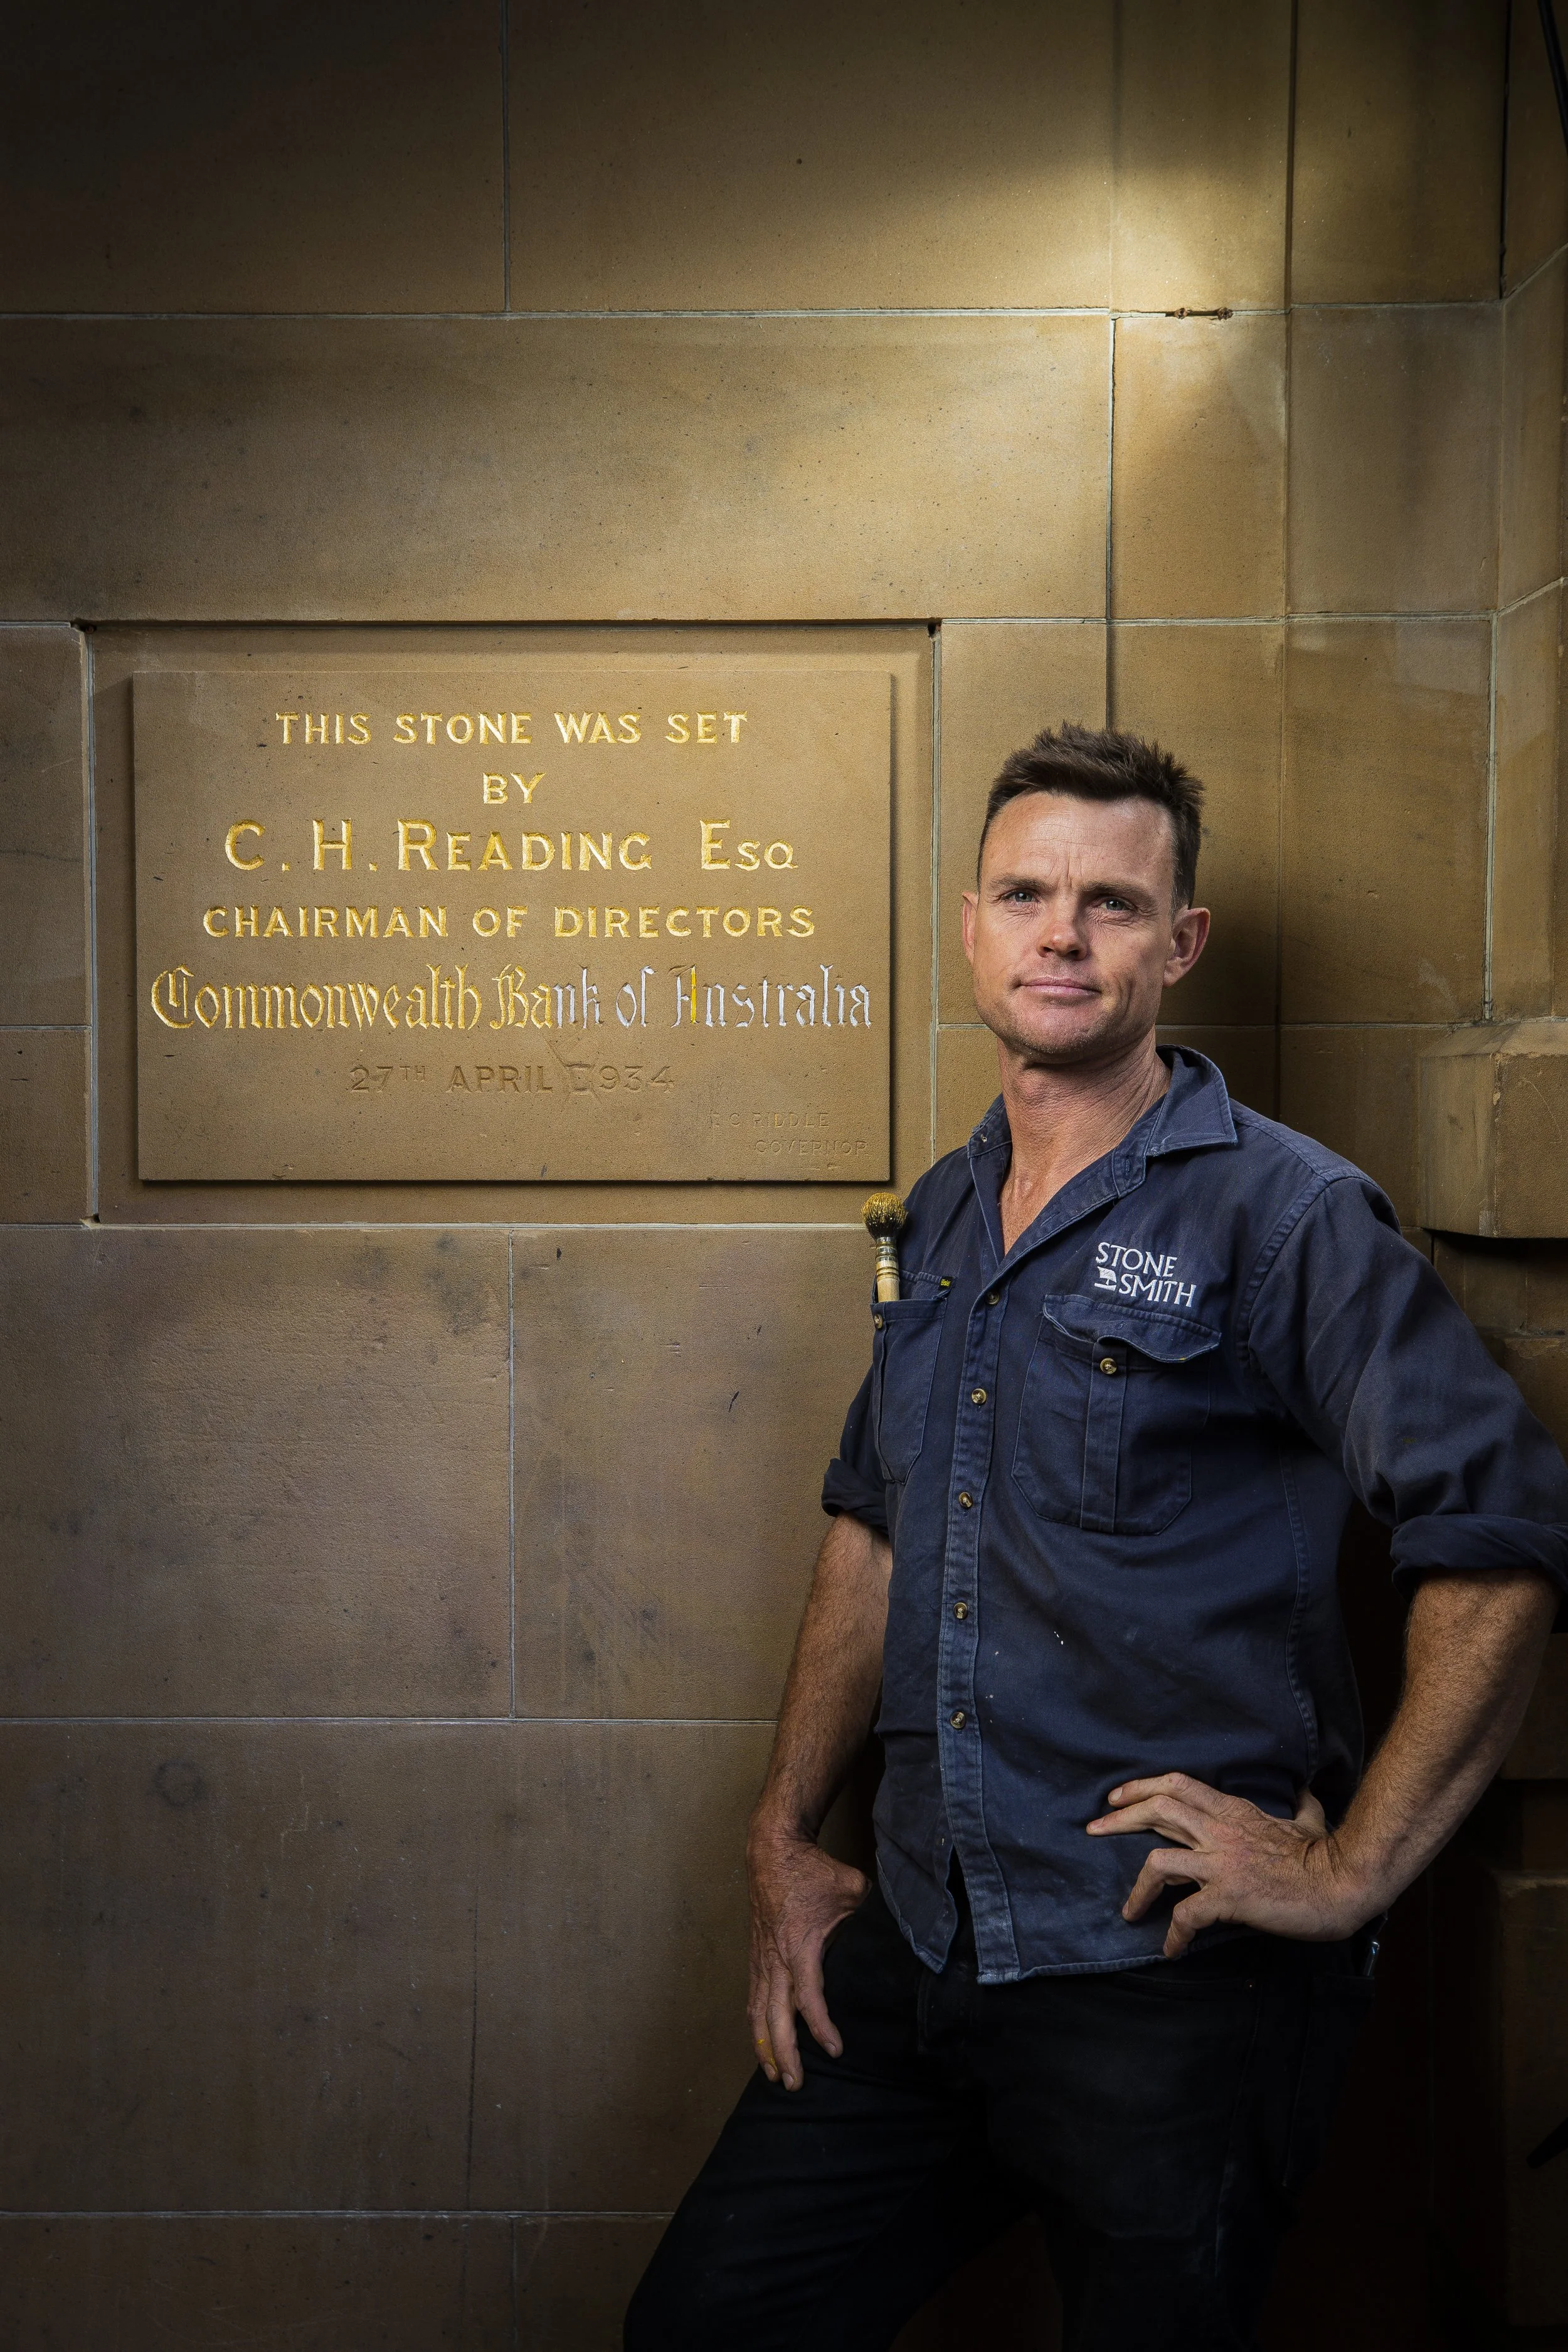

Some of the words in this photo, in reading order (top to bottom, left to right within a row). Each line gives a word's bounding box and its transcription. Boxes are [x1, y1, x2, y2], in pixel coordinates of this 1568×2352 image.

[276, 711, 372, 745] THIS
[393, 711, 532, 745] STONE
[553, 711, 642, 744] WAS
[665, 710, 748, 744] SET
[482, 771, 546, 805] BY
[397, 818, 653, 871] READING
[203, 906, 449, 938] CHAIRMAN
[472, 906, 529, 938] OF
[553, 904, 815, 938] DIRECTORS
[151, 963, 483, 1031] Commonwealth
[489, 963, 605, 1030] Bank
[615, 964, 659, 1029] of
[668, 963, 872, 1030] Australia
[349, 1064, 426, 1093] 27TH
[445, 1065, 554, 1093] APRIL
[751, 1111, 830, 1128] RIDDLE
[754, 1138, 869, 1157] GOVERNOR
[1095, 1241, 1178, 1278] STONE
[1118, 1273, 1197, 1308] SMITH
